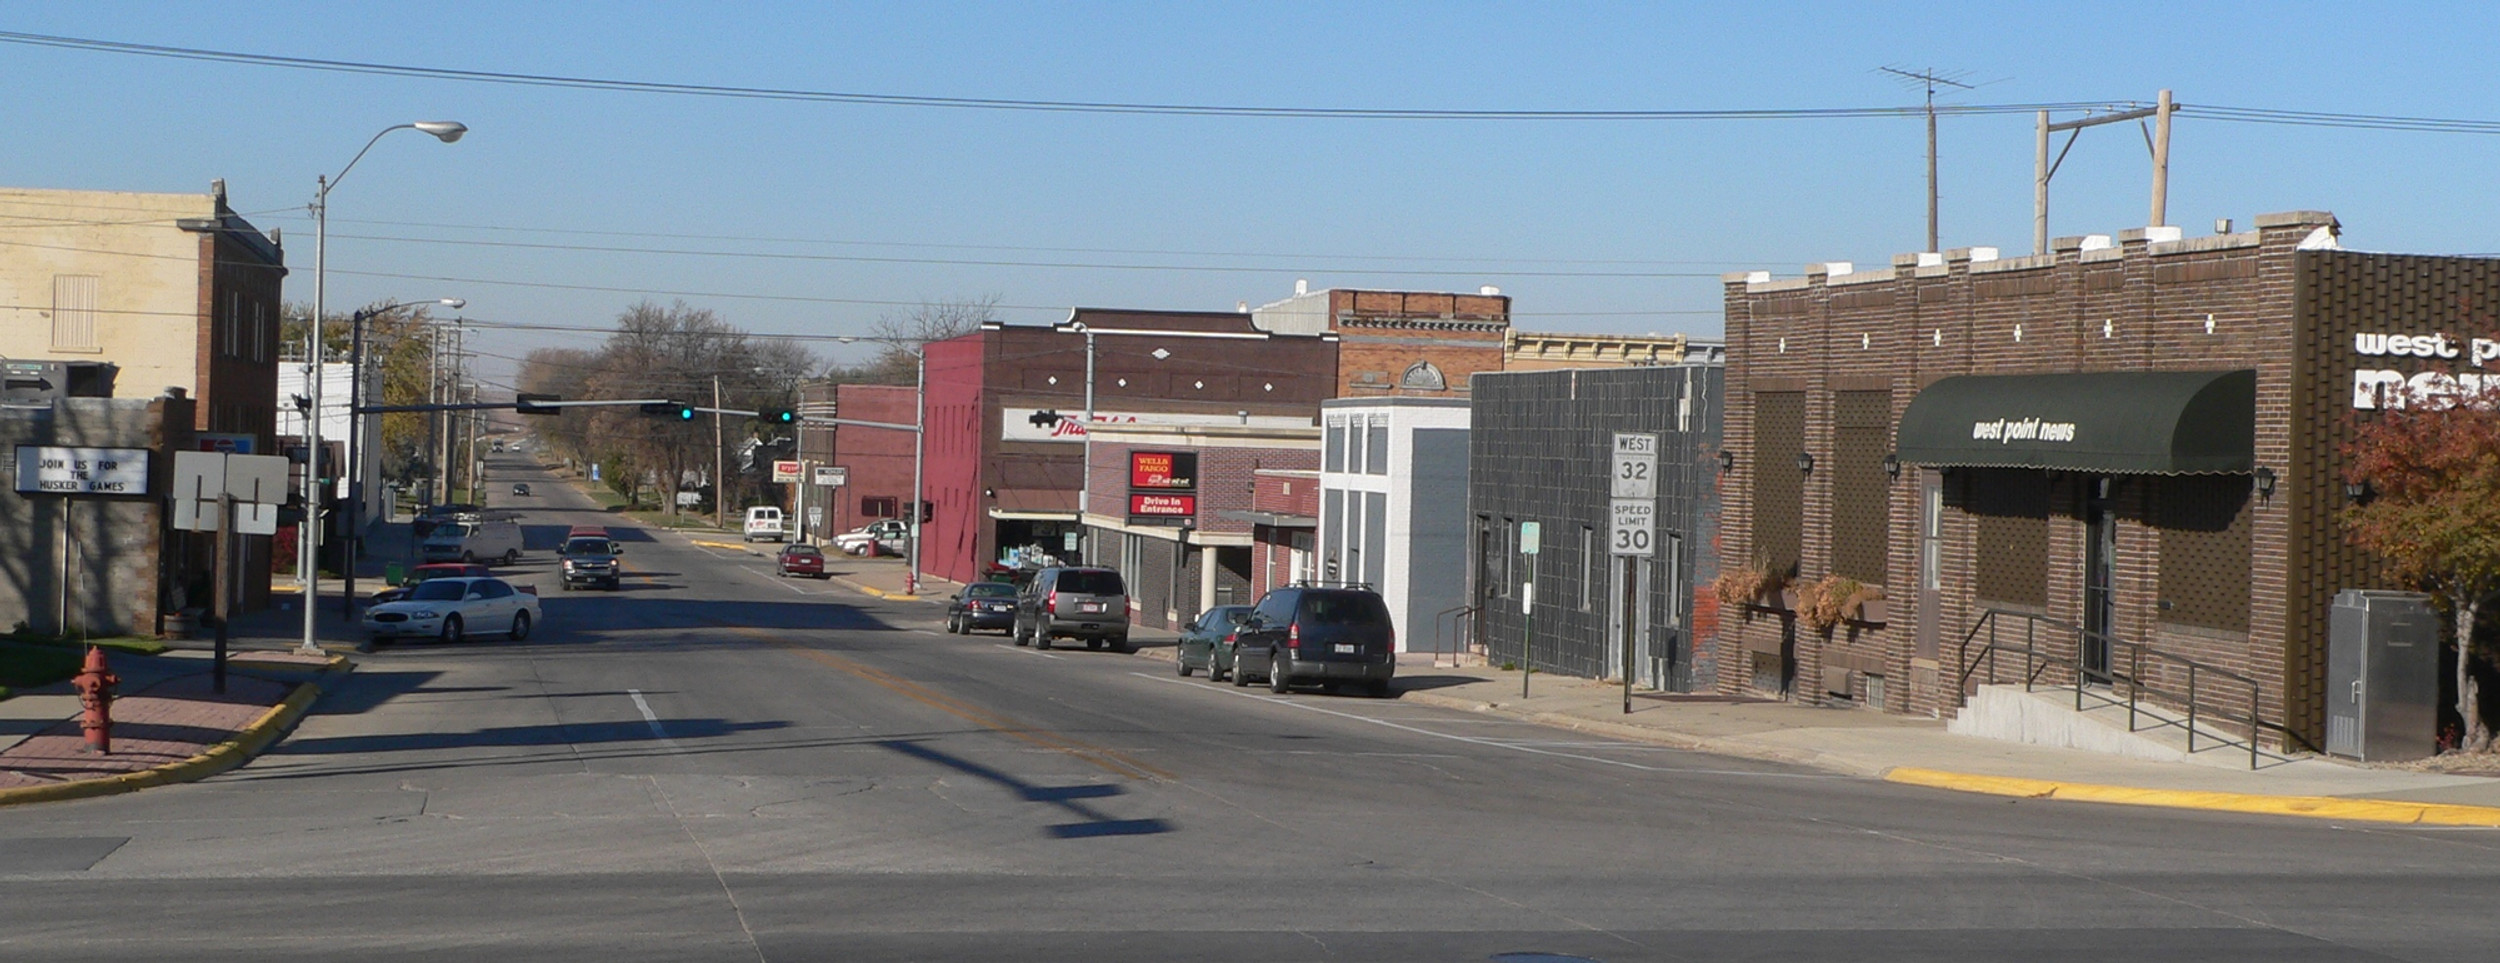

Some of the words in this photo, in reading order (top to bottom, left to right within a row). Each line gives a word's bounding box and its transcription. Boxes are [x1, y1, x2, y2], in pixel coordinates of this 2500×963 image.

[2355, 332, 2459, 358] west
[1973, 418, 2005, 440] west
[2002, 417, 2040, 445] point
[2038, 421, 2076, 443] news
[1619, 437, 1651, 452] WEST
[39, 459, 64, 470] JOIN
[74, 460, 88, 470] US
[98, 461, 118, 470] FOR
[1138, 457, 1168, 465] WELLS
[1139, 464, 1168, 472] FARGO
[1621, 461, 1647, 480] 32
[70, 470, 89, 480] THE
[39, 480, 78, 490] HUSKER
[89, 481, 125, 491] GAMES
[1143, 496, 1169, 506] Drive
[1171, 497, 1181, 506] In
[1140, 504, 1184, 514] Entrance
[1614, 505, 1651, 515] SPEED
[1618, 516, 1647, 526] LIMIT
[1615, 529, 1649, 549] 30
